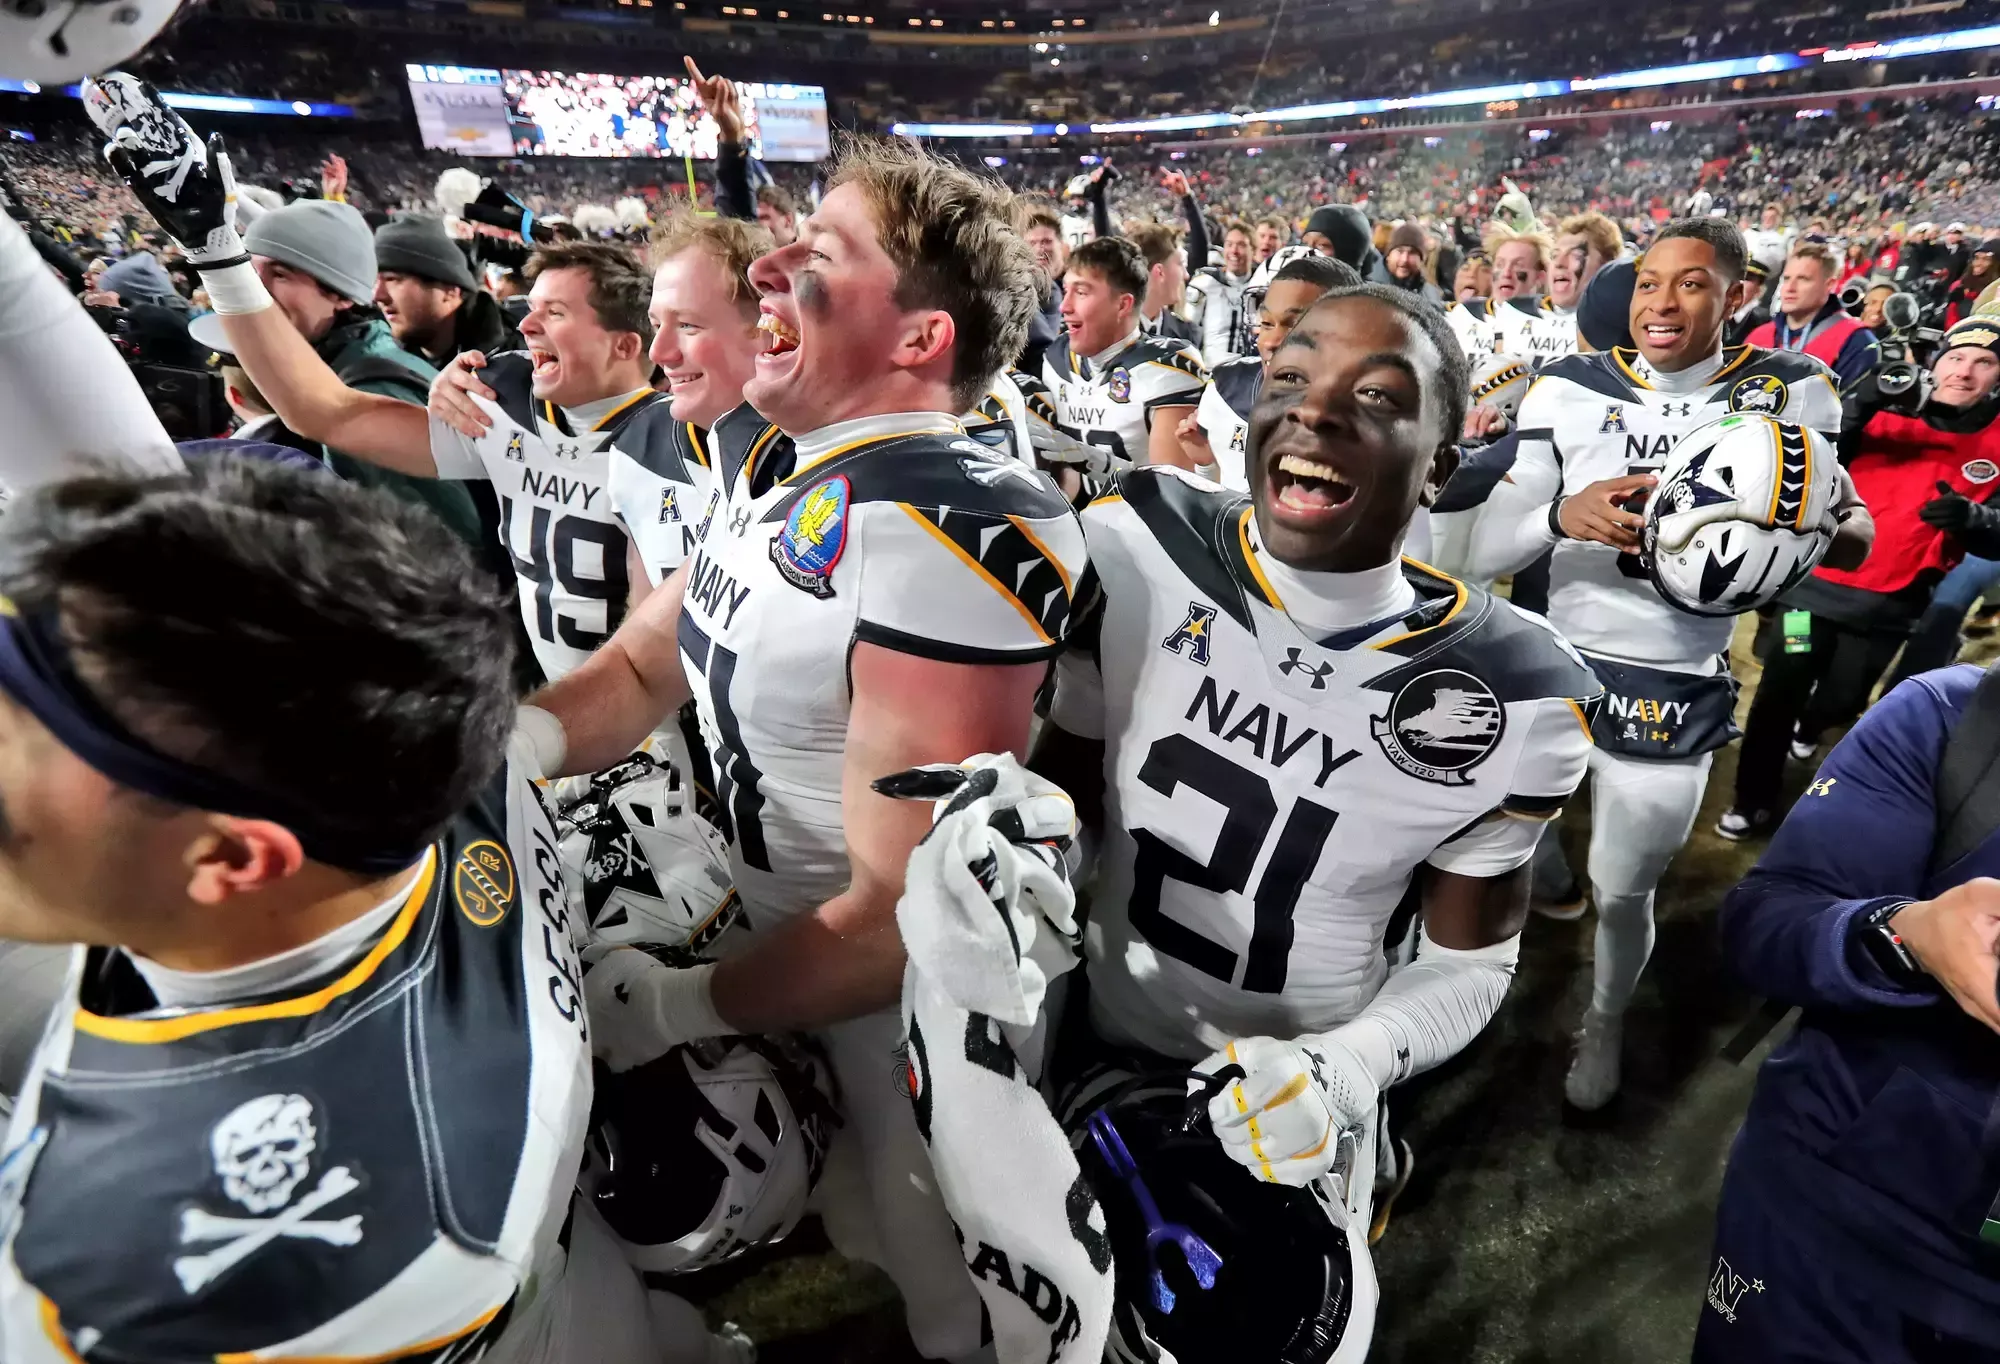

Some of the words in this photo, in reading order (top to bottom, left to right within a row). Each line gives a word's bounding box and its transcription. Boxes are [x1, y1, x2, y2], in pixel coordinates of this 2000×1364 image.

[1527, 336, 1576, 353] NAVY
[1068, 406, 1106, 426] NAVY
[1624, 434, 1679, 459] NA
[521, 467, 601, 510] NAVY
[502, 494, 630, 652] 49
[687, 549, 751, 630] NAVY
[801, 575, 817, 586] TWO
[1608, 692, 1692, 725] NAVY
[1184, 676, 1363, 789] NAVY
[1387, 742, 1436, 778] VAW-120
[480, 851, 501, 872] R
[1127, 732, 1340, 996] 21
[466, 889, 487, 914] J
